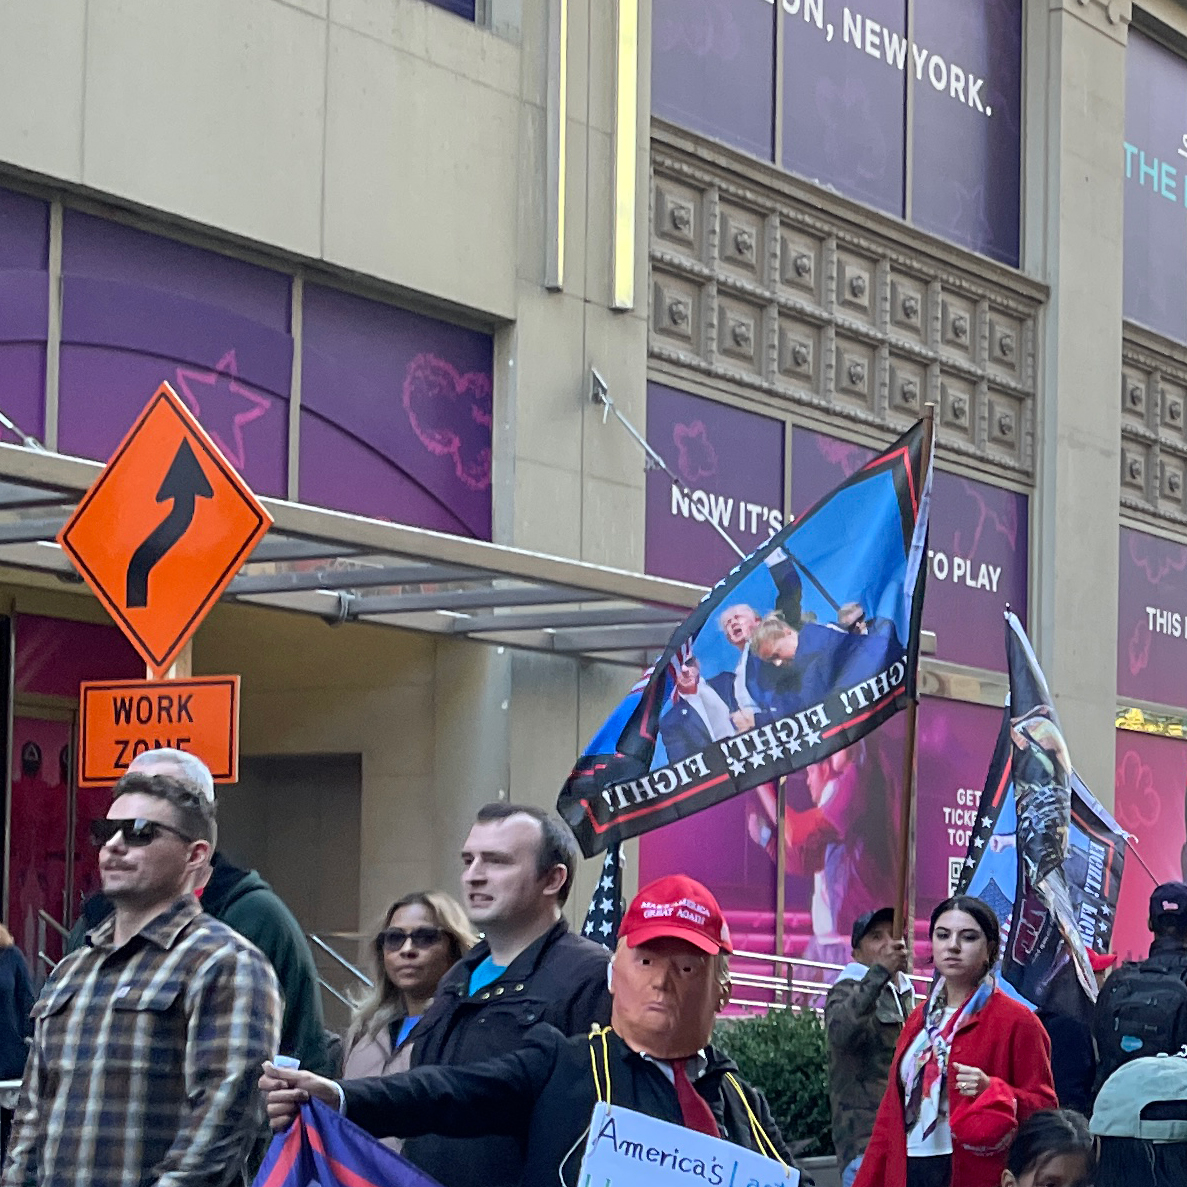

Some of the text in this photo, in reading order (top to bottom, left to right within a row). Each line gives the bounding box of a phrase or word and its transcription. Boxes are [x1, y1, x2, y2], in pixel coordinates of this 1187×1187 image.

[843, 7, 908, 70] NEW
[912, 43, 992, 117] YORK.
[1123, 141, 1177, 202] THE
[671, 484, 1002, 593] NOW IT'S O PLAY
[1146, 606, 1182, 638] THIS
[112, 694, 195, 726] WORK
[112, 737, 192, 770] ZO
[957, 788, 983, 807] GET
[943, 807, 978, 827] TICKE
[593, 1116, 724, 1187] America's
